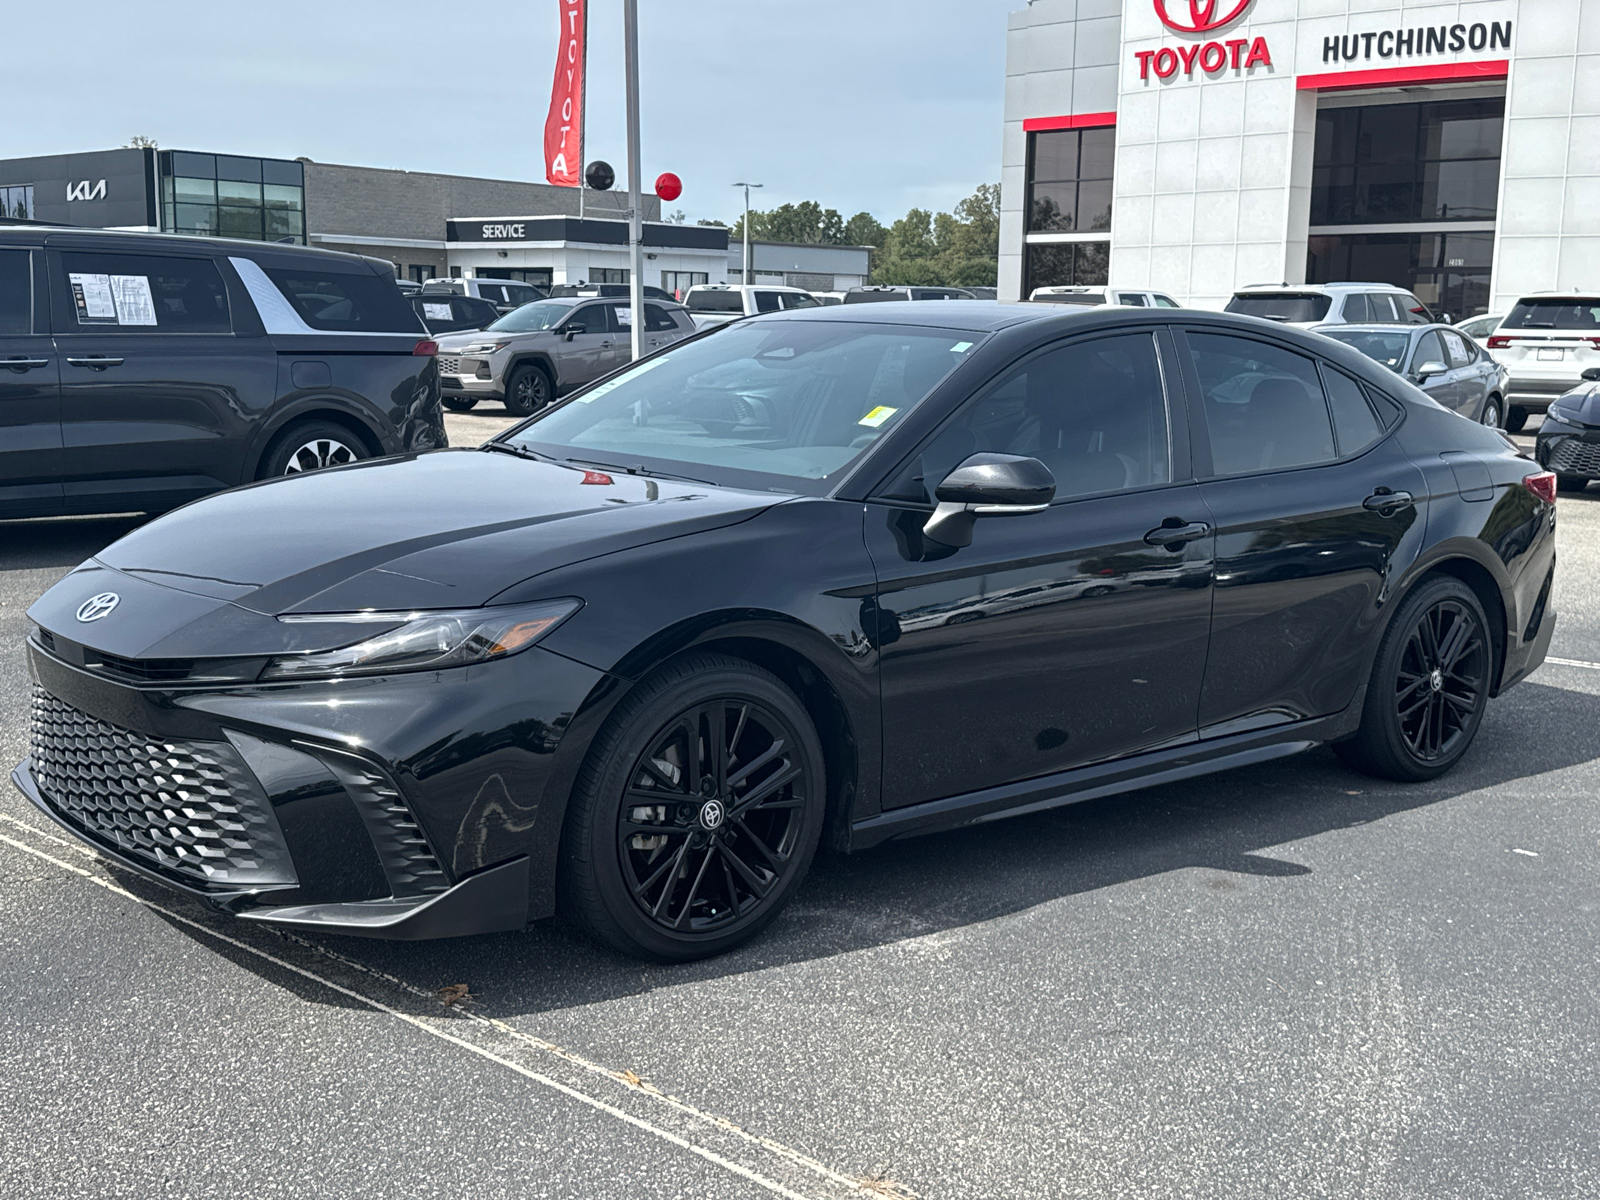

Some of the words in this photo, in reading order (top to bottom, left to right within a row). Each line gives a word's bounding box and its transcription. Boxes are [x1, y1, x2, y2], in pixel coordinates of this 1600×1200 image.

[1134, 36, 1272, 80] TOYOTA
[1322, 20, 1512, 62] HUTCHINSON
[552, 10, 578, 177] TOYOTA
[66, 179, 107, 201] KIA
[482, 223, 526, 238] SERVICE
